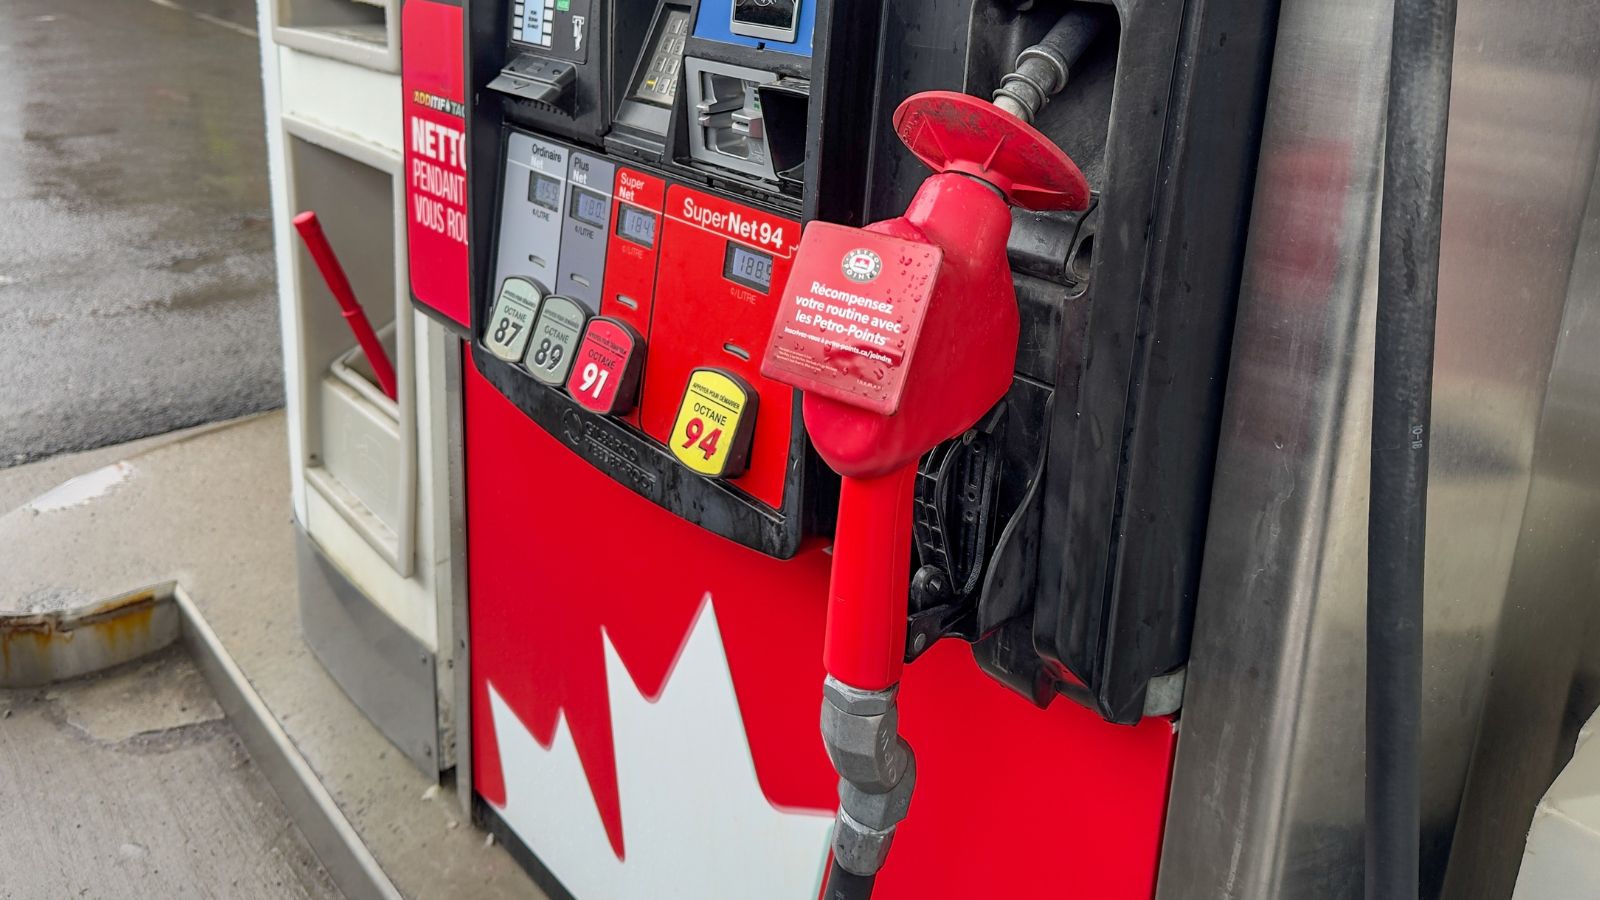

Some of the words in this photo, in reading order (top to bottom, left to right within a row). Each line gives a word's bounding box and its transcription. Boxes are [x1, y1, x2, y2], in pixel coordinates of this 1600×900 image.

[531, 143, 562, 163] Ordinaire
[531, 155, 544, 170] Net
[574, 157, 590, 171] Plus
[413, 158, 465, 207] PENDANT
[572, 170, 587, 185] Net
[620, 172, 645, 190] Super
[618, 186, 635, 201] Net
[414, 193, 445, 234] VOUS
[810, 281, 894, 314] Récompensez
[504, 306, 528, 323] OCTANE
[795, 295, 825, 311] votre
[825, 304, 870, 324] routine
[870, 317, 902, 333] avec
[796, 309, 811, 324] les
[494, 317, 524, 347] 87
[544, 325, 570, 344] OCTANE
[535, 338, 565, 373] 89
[588, 349, 617, 370] OCTANE
[579, 362, 609, 399] 91
[694, 402, 728, 427] OCTANE
[682, 417, 723, 461] 94
